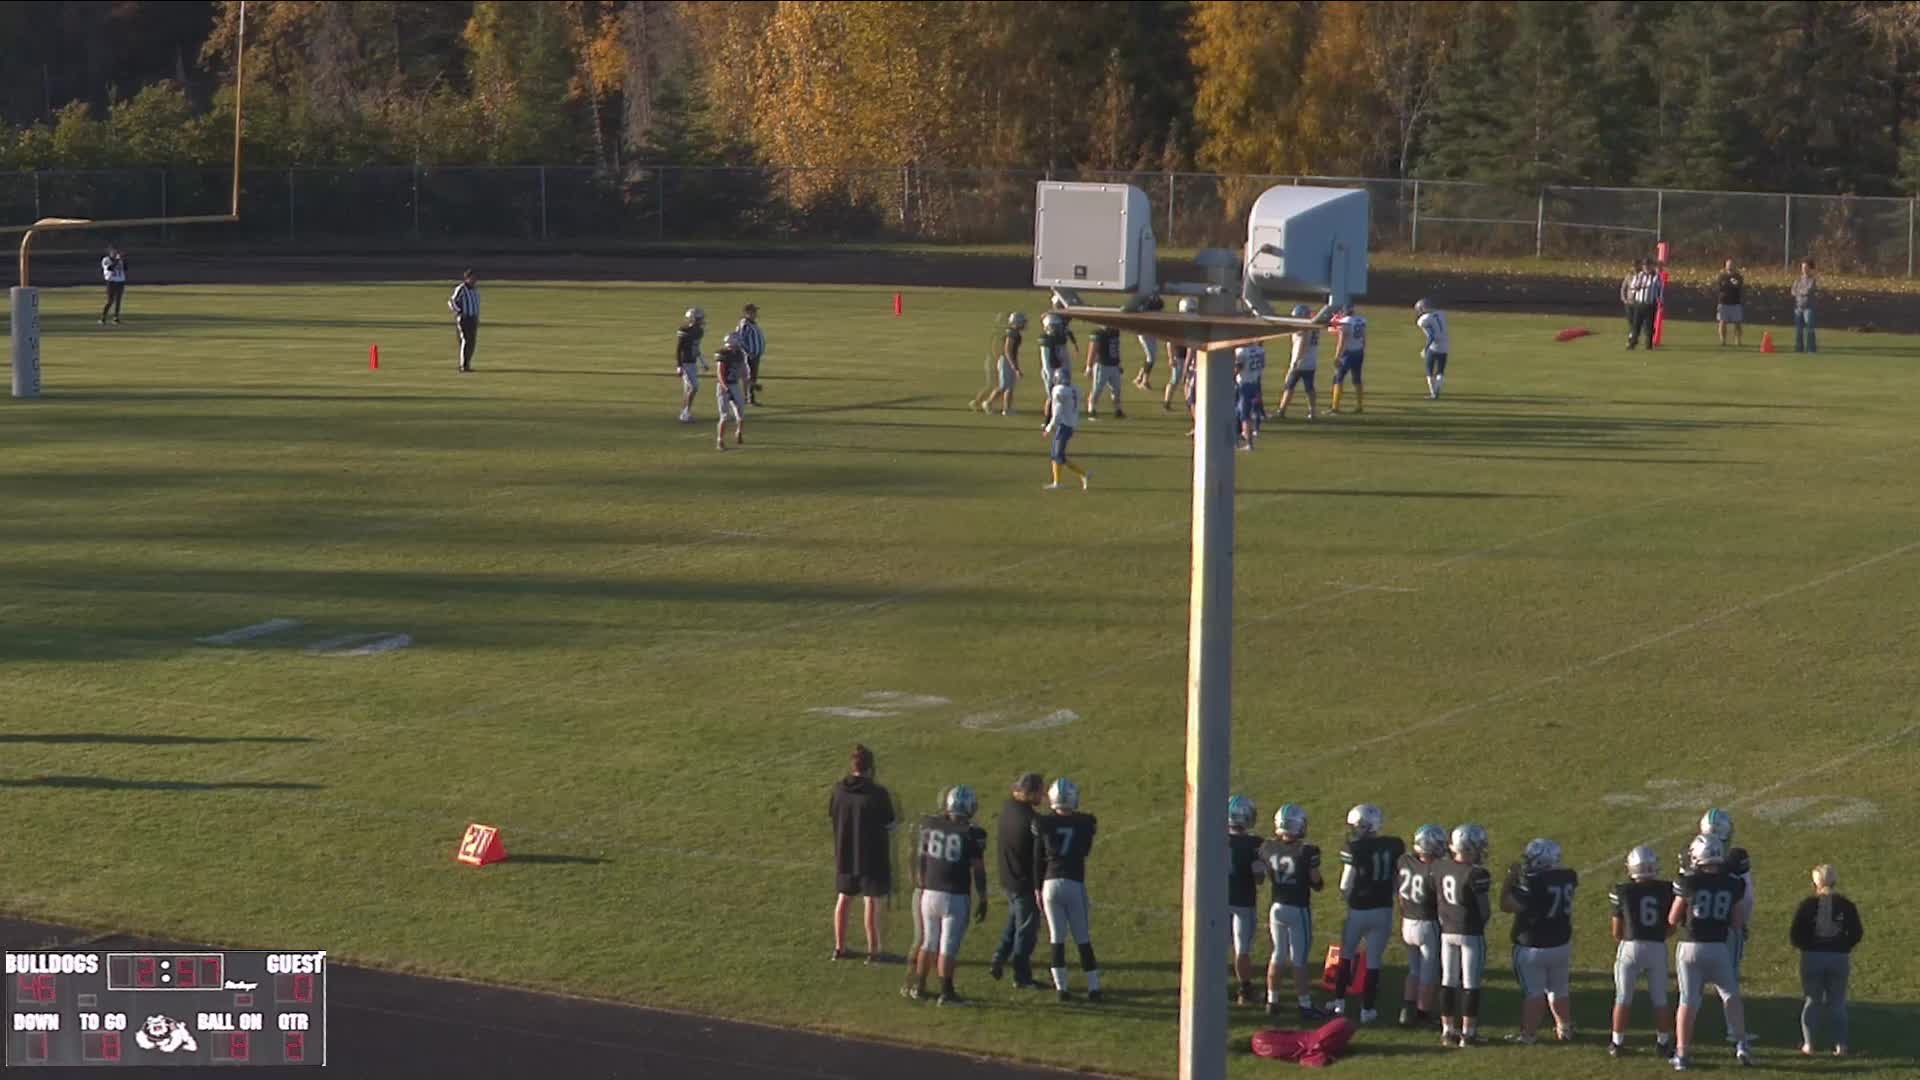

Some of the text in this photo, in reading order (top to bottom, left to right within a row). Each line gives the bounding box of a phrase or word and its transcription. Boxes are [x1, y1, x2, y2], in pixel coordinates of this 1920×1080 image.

[462, 826, 496, 858] 20
[1056, 827, 1073, 857] 7
[1269, 854, 1297, 884] 12
[1373, 850, 1391, 881] 11
[1399, 868, 1425, 904] 28
[1442, 874, 1457, 905] 8
[1640, 896, 1657, 927] 6
